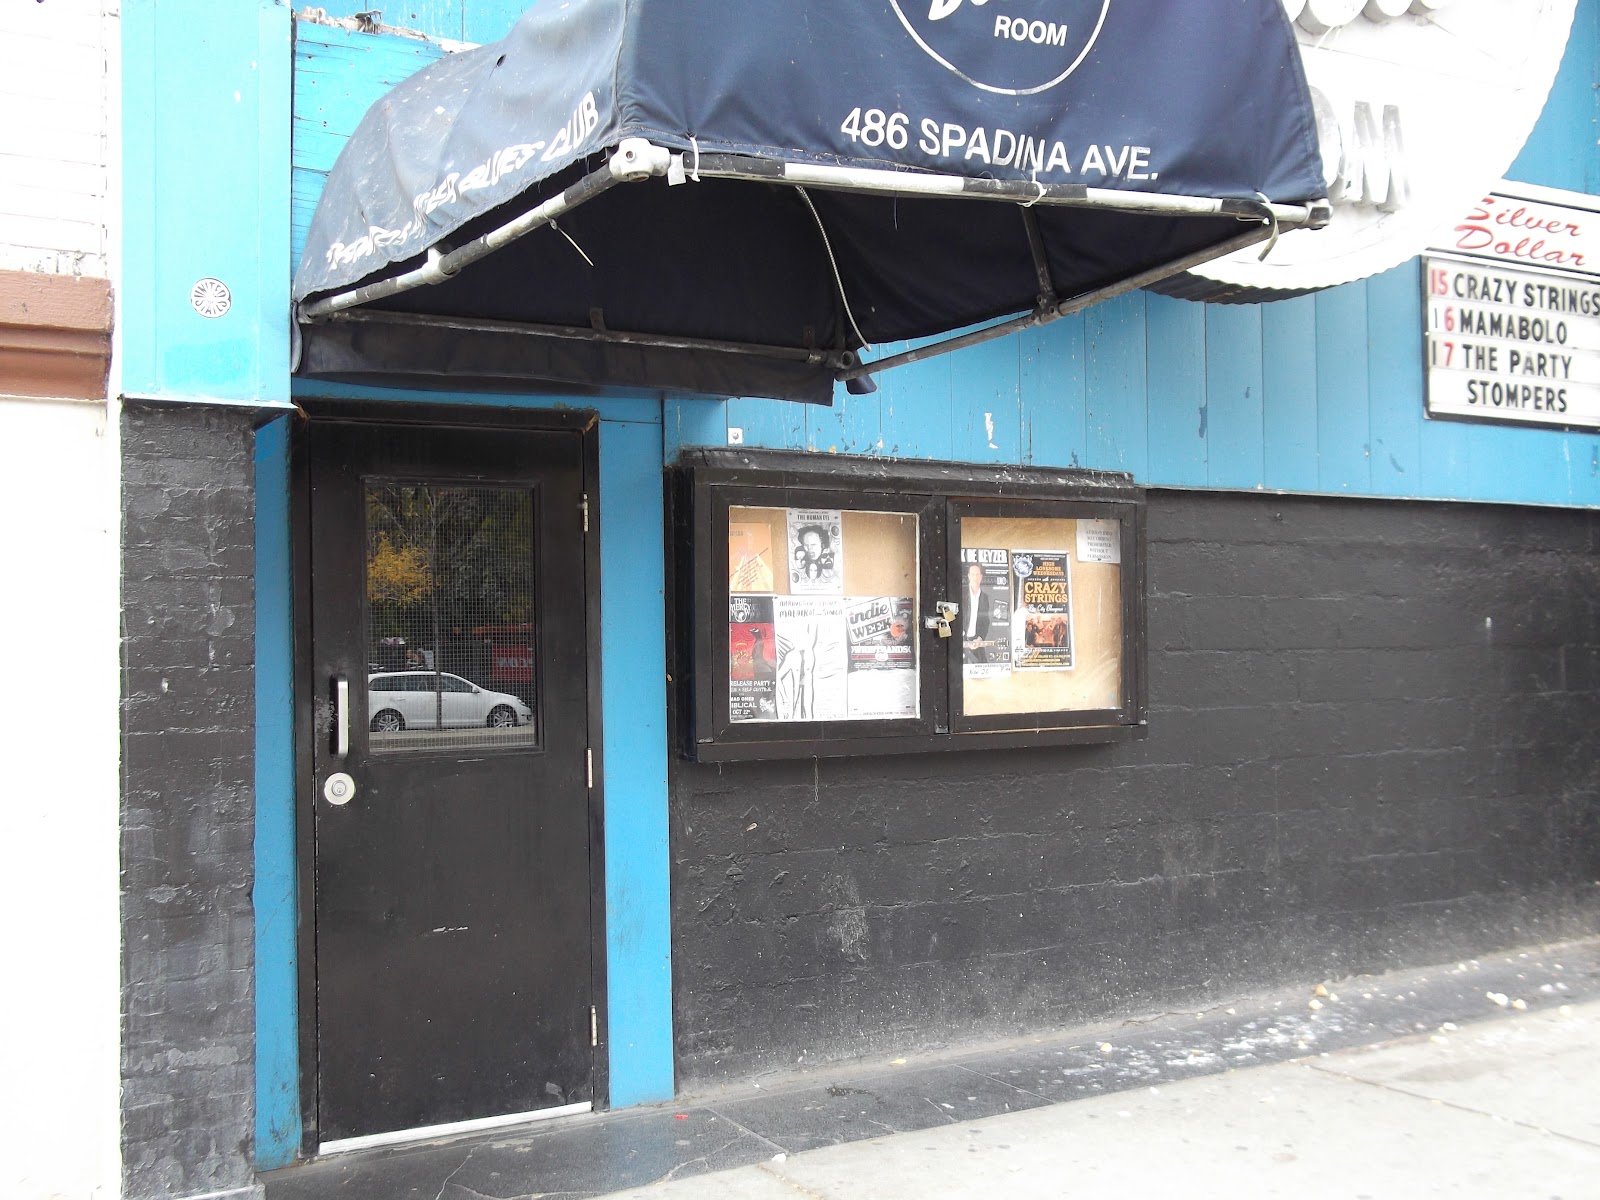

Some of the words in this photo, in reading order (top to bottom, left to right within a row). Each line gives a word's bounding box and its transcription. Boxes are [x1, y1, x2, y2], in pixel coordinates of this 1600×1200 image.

[993, 15, 1067, 46] ROOM
[458, 140, 546, 197] BLUES
[541, 91, 599, 162] CLUB
[840, 107, 910, 150] 486
[919, 117, 1072, 174] SPADINA
[1080, 144, 1159, 181] AVE.
[1464, 197, 1583, 237] Silver
[1454, 224, 1587, 267] Dollar
[1431, 269, 1449, 296] 15
[1454, 273, 1517, 305] CRAZY
[1524, 282, 1600, 317] STRINGS
[1460, 307, 1567, 345] MAMABOLO
[1462, 343, 1498, 372] THE
[1509, 349, 1572, 379] PARTY
[1467, 379, 1567, 413] STOMPERS
[978, 549, 1008, 563] KEYZER
[1024, 581, 1067, 594] CRAZY
[1024, 593, 1068, 603] STRINGS
[849, 602, 889, 625] indie
[851, 617, 893, 639] WEEK
